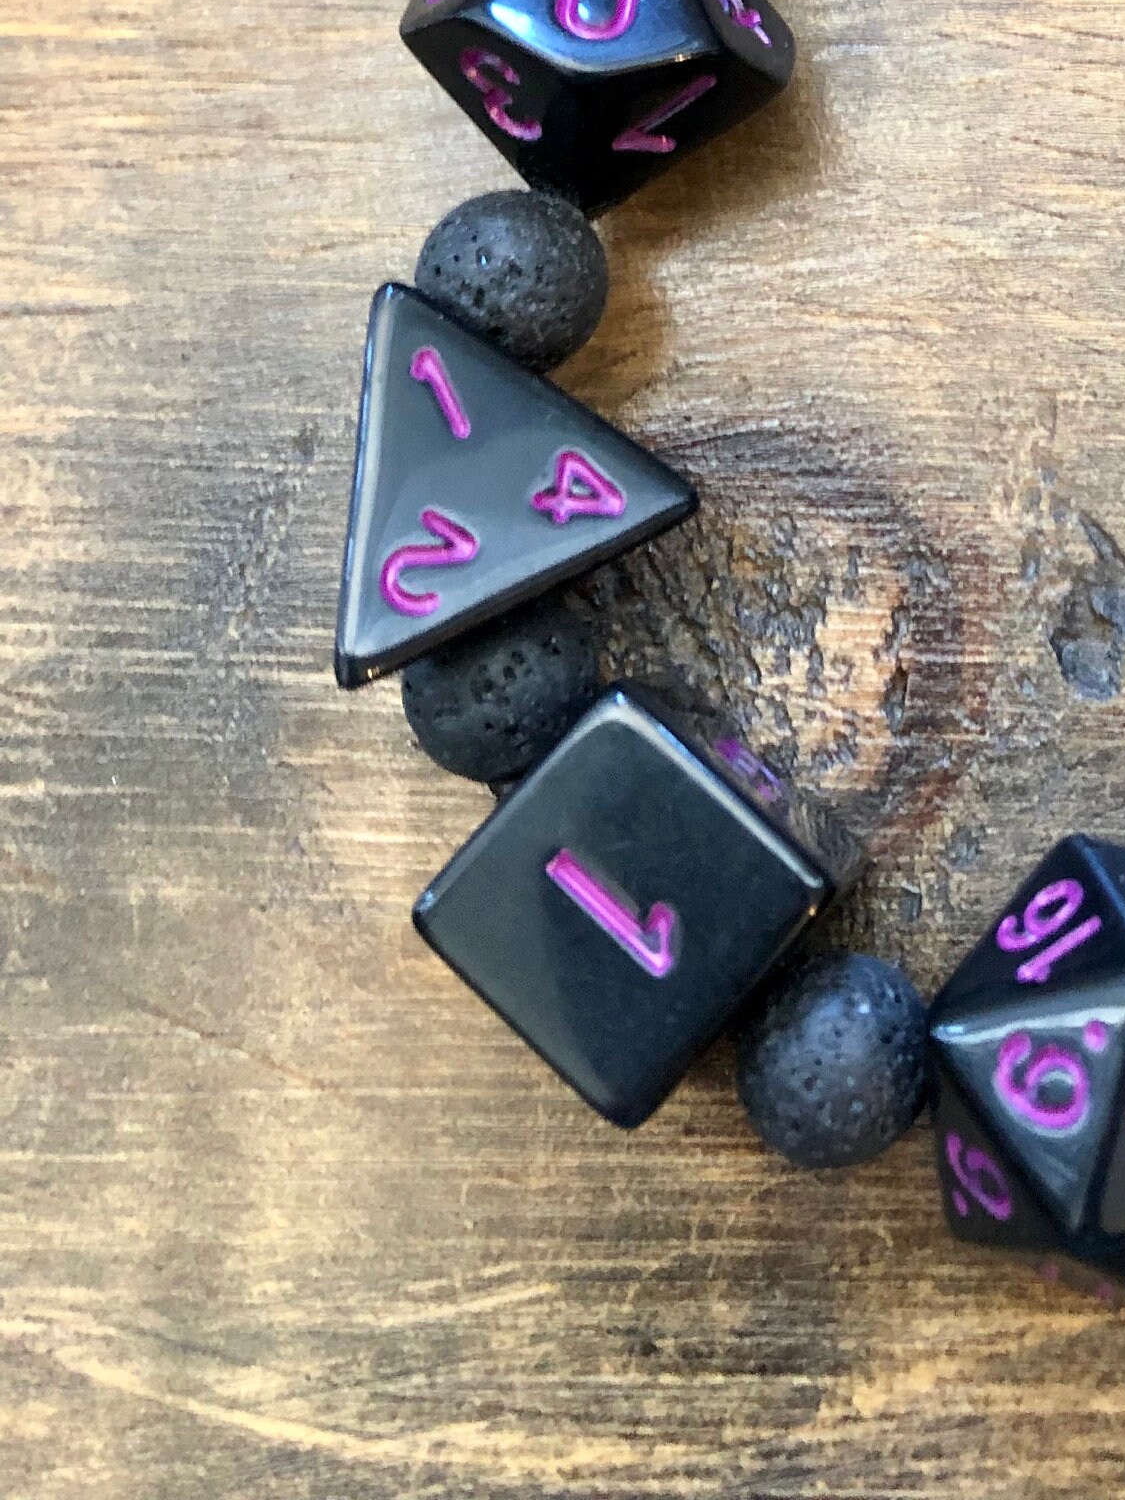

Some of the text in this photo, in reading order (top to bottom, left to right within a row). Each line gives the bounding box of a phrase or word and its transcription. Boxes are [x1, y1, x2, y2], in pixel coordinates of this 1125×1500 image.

[459, 46, 543, 142] 3
[612, 74, 717, 155] 7
[411, 346, 472, 440] 1
[530, 449, 627, 526] 4
[379, 508, 480, 617] 2
[545, 847, 677, 979] 1
